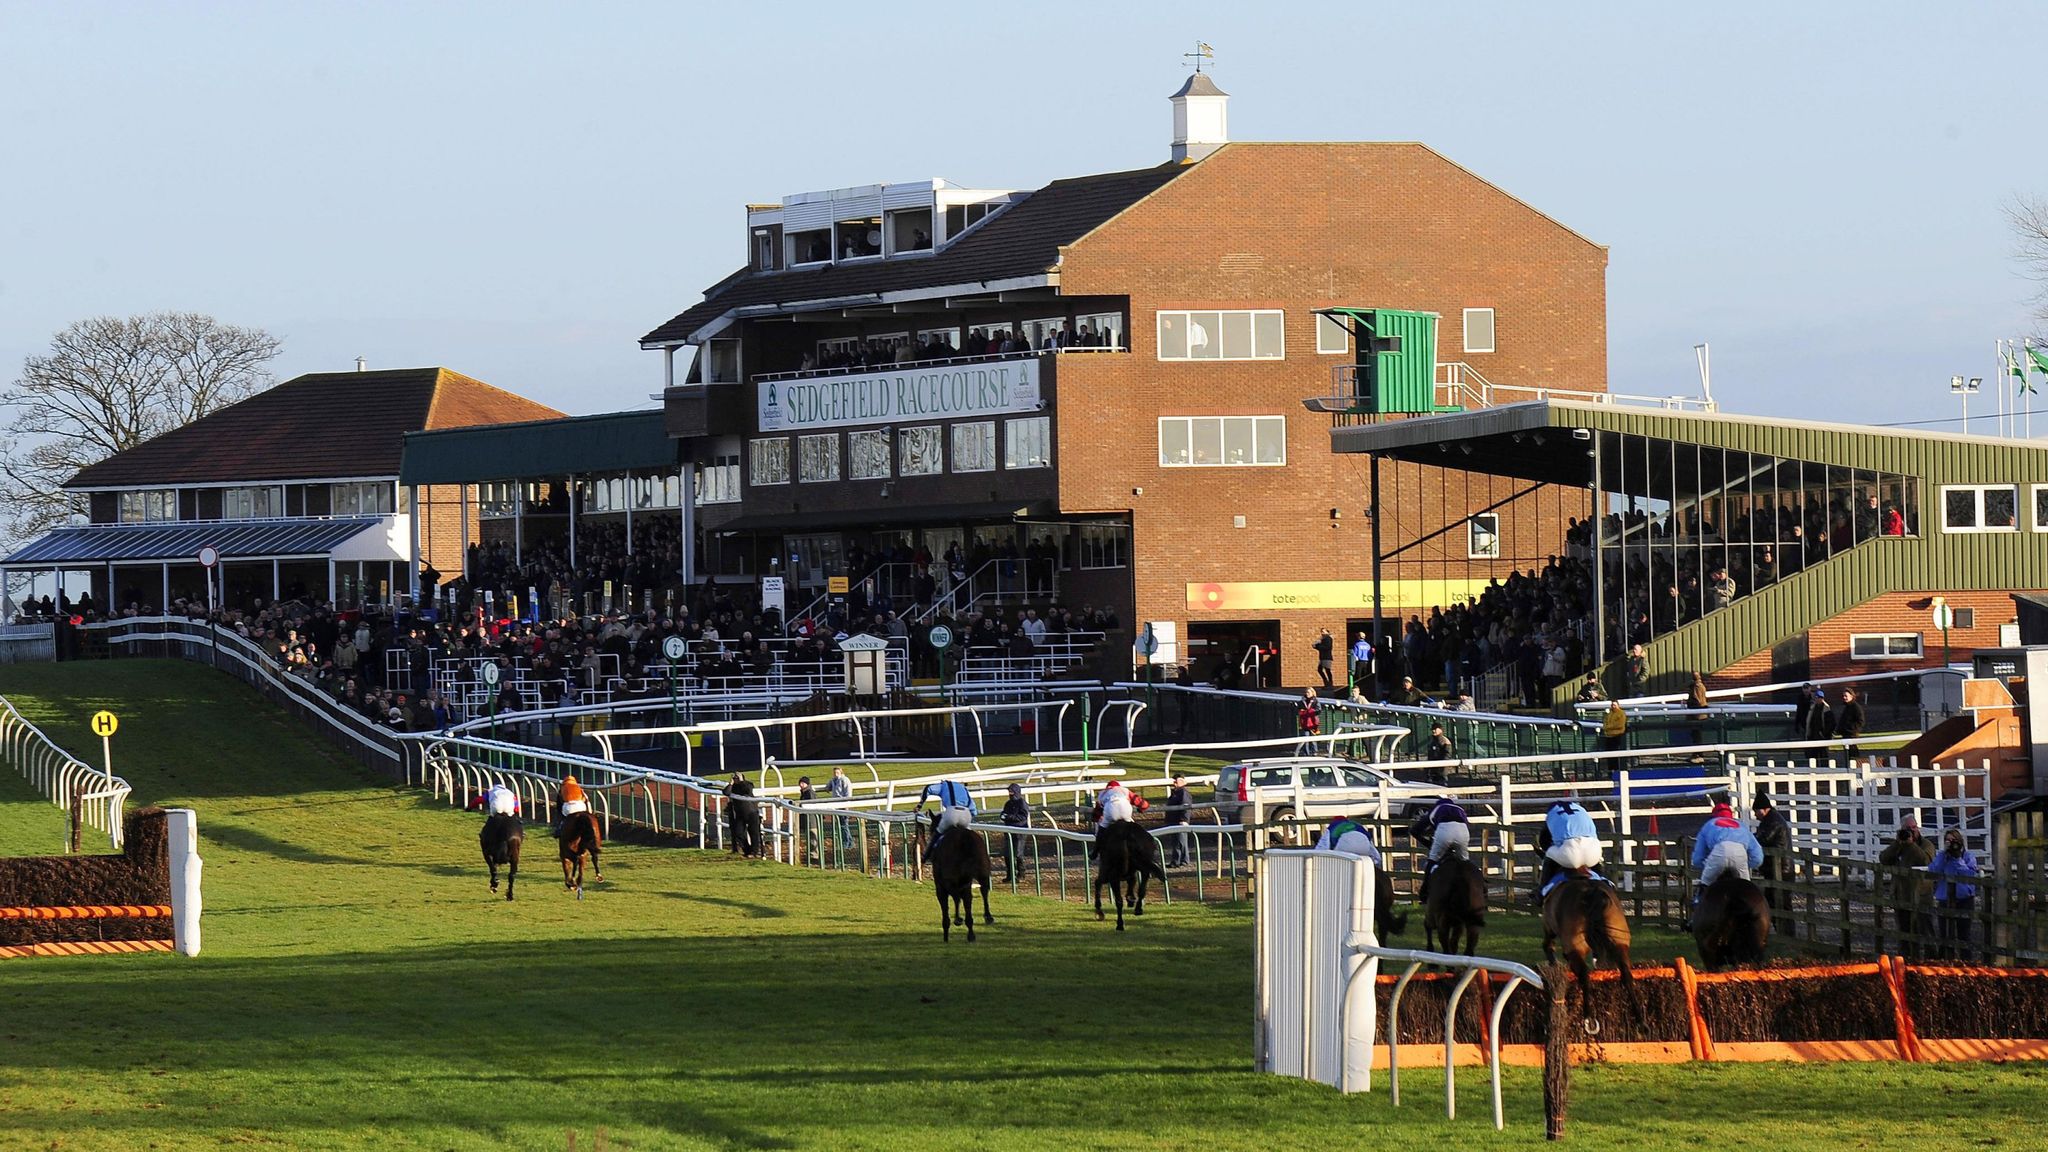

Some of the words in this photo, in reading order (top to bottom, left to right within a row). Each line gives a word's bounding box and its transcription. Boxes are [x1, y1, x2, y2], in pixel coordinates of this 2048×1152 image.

[787, 378, 890, 424] SEDGEFIELD
[895, 368, 1010, 416] RACECOURSE
[1272, 594, 1321, 605] totepool
[1362, 592, 1410, 604] toepool
[97, 715, 112, 732] H
